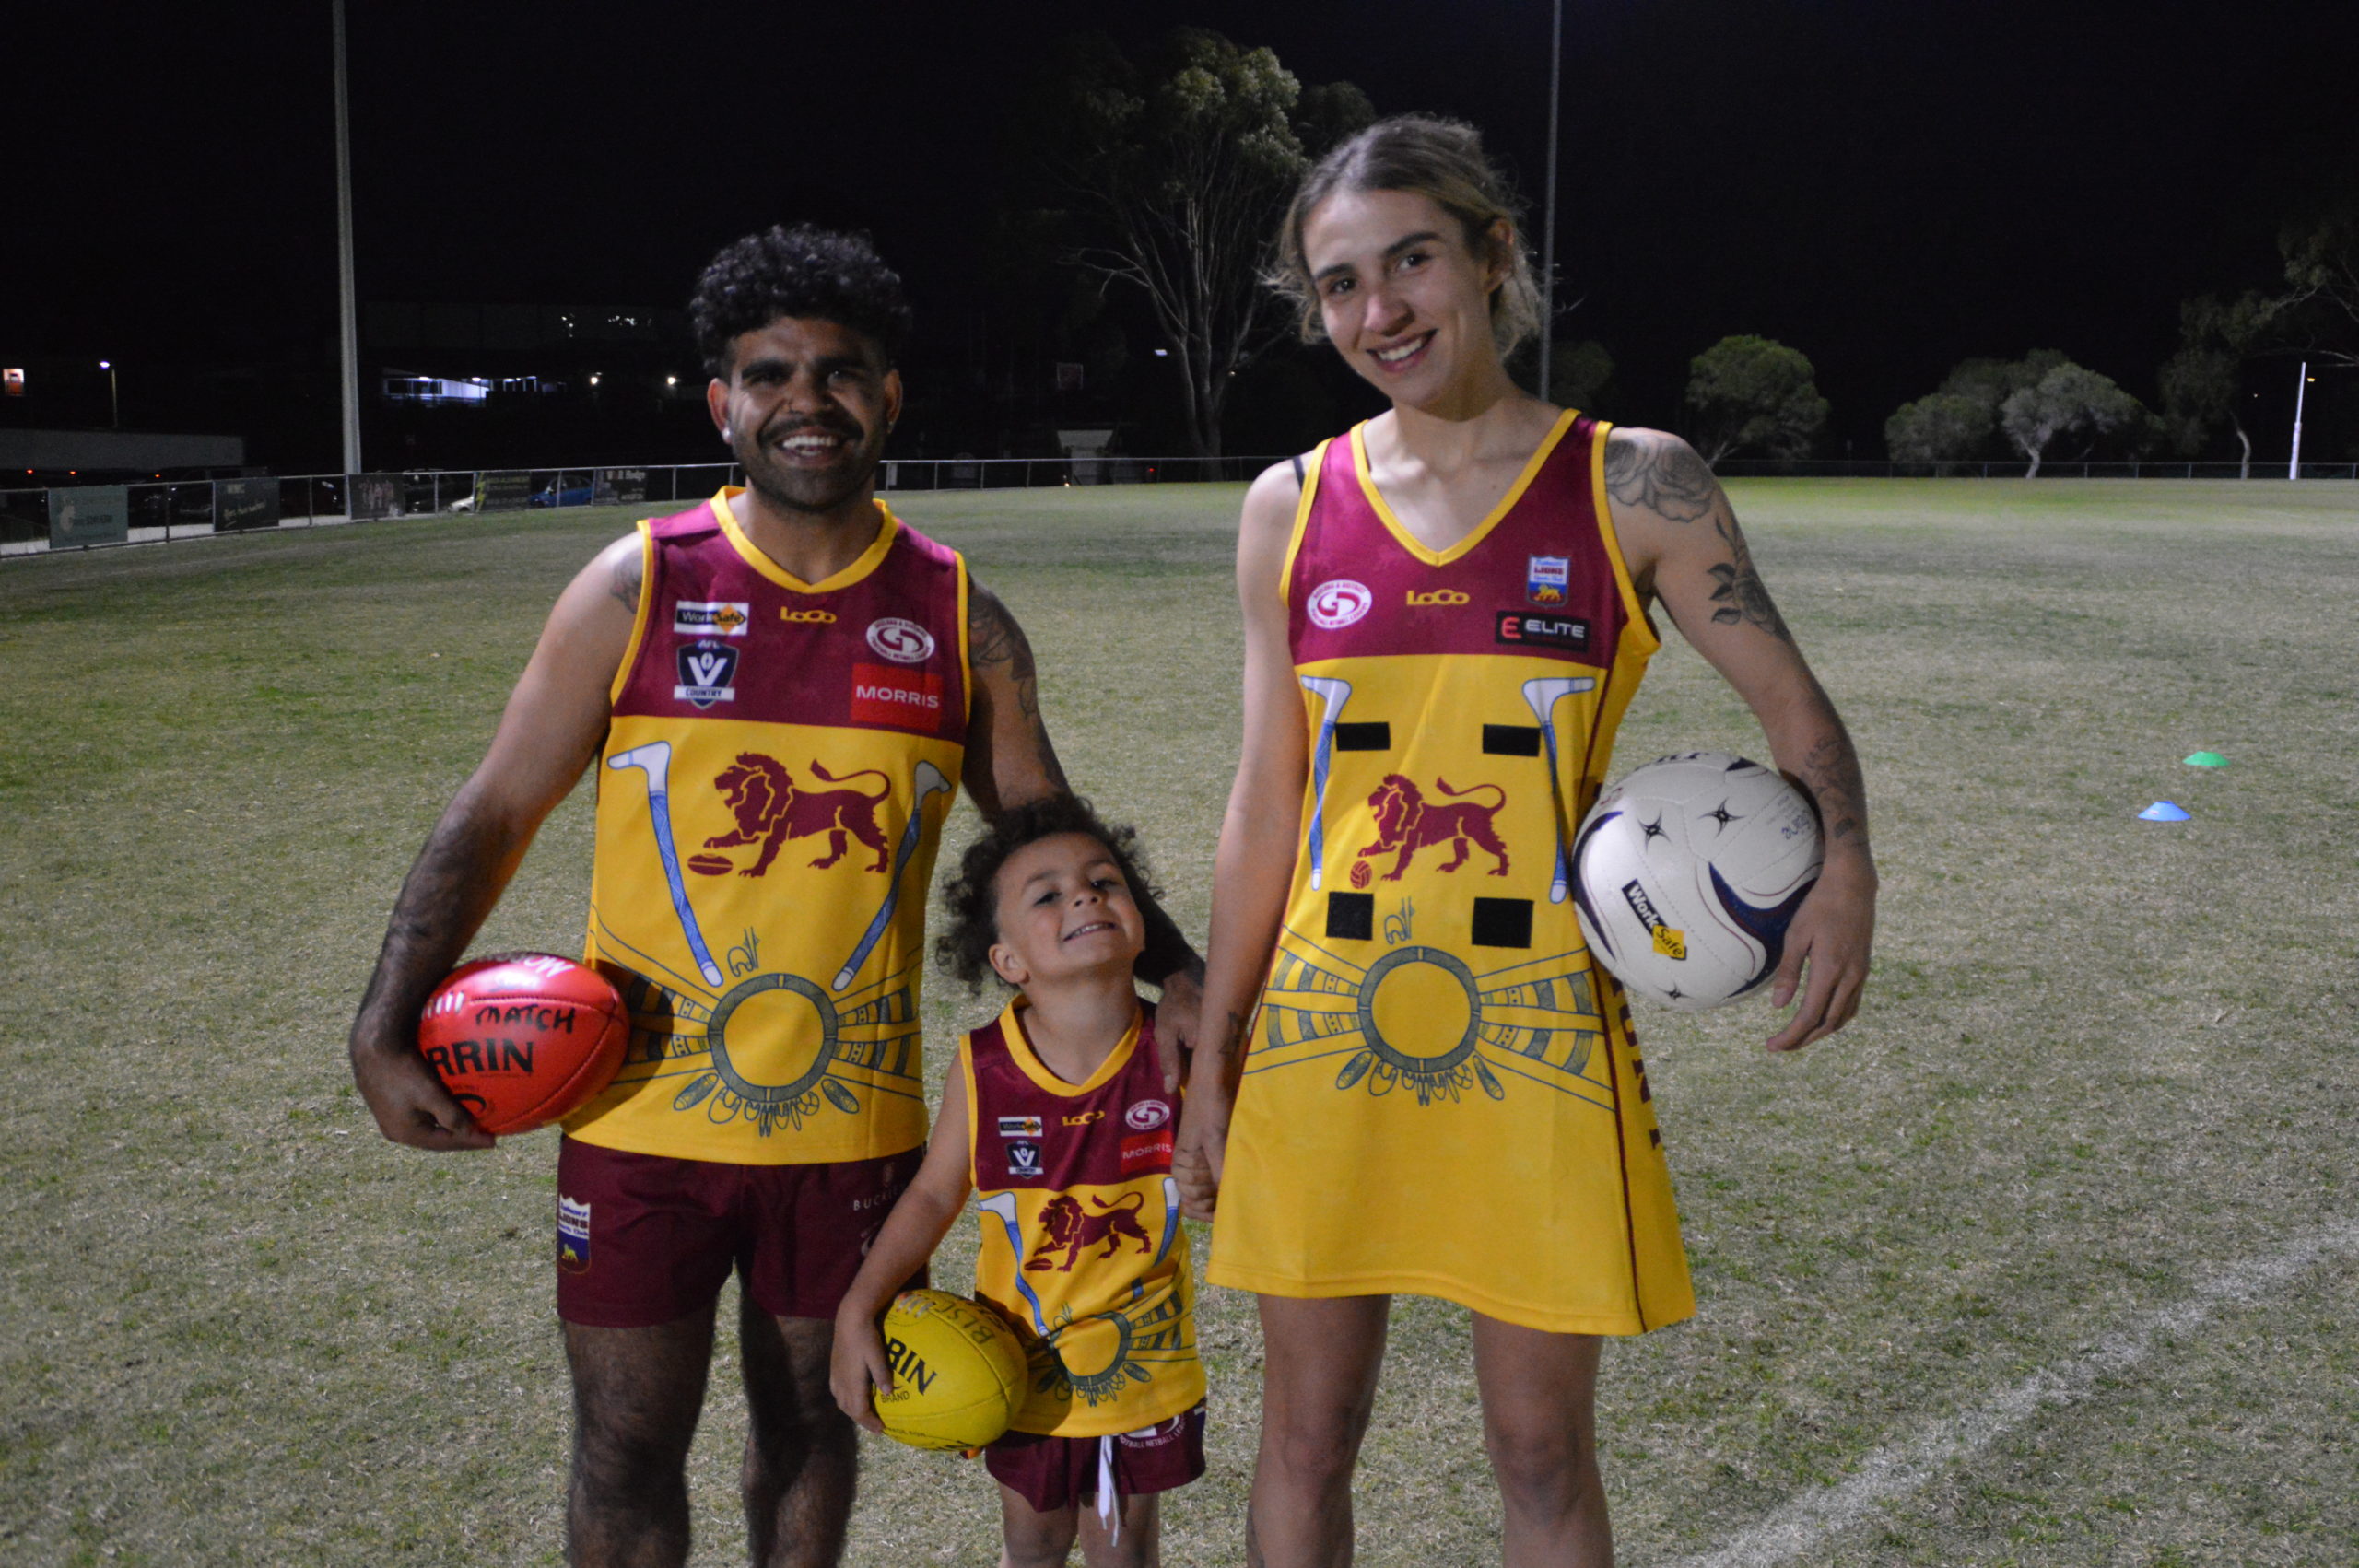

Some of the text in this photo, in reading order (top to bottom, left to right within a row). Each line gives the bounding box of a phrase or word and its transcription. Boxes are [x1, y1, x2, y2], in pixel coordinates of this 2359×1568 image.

[1525, 619, 1585, 638] ELITE
[686, 688, 723, 697] COUNTRY
[856, 685, 939, 708] MORRIS
[475, 1003, 576, 1034] MATCH
[1122, 1143, 1172, 1160] MORRIS
[881, 1391, 910, 1403] BRAND
[1145, 1435, 1175, 1447] NETBALL
